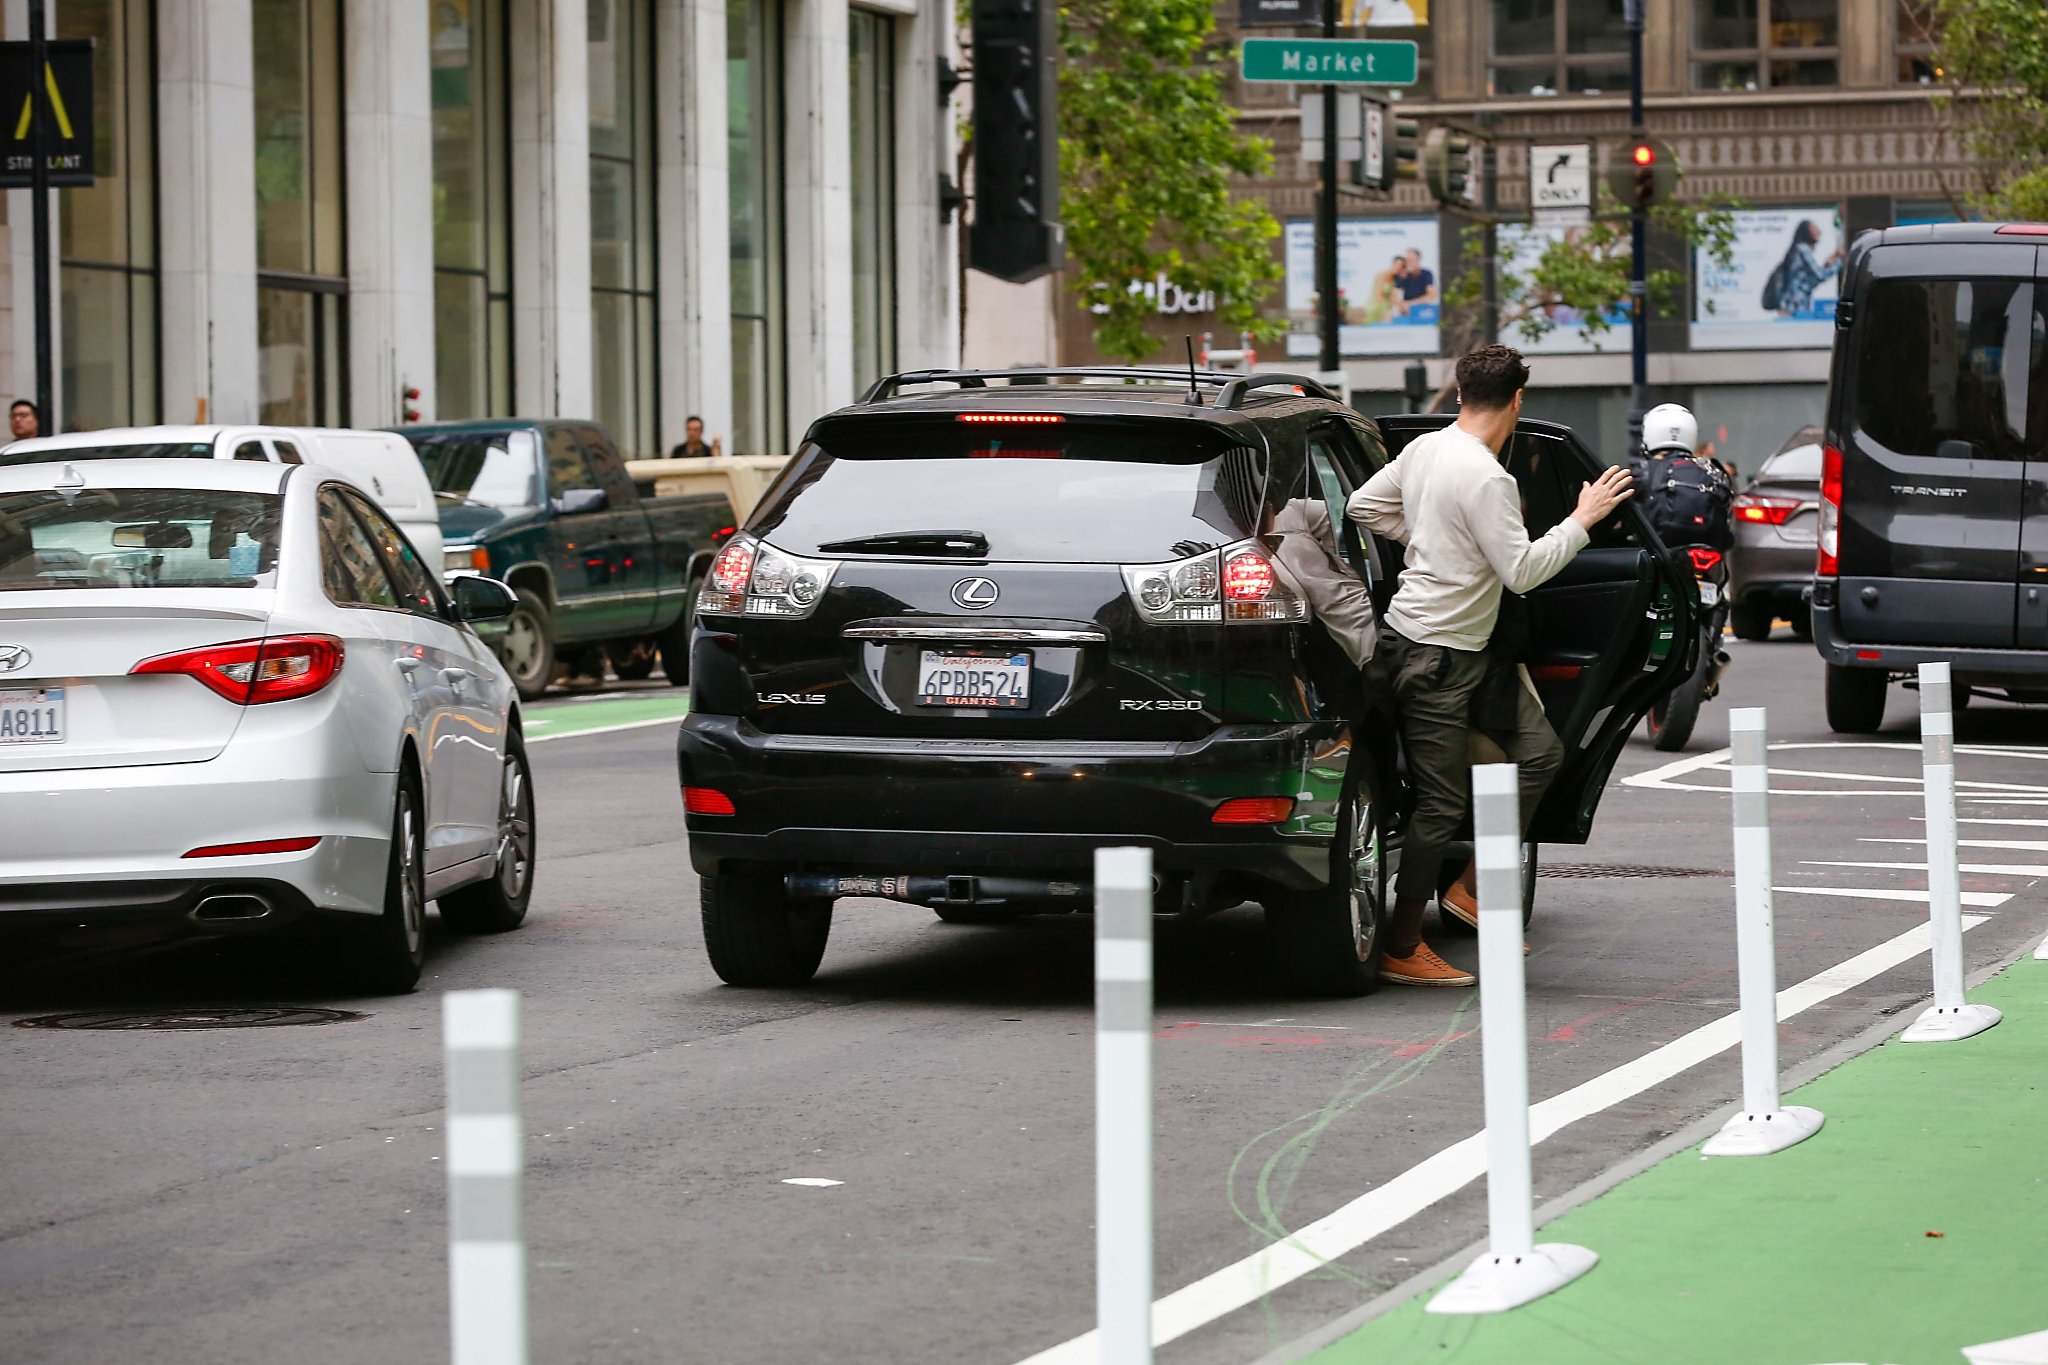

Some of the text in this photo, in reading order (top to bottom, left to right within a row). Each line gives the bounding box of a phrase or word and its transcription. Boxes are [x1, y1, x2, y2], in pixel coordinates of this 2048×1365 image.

[1283, 50, 1376, 72] Market
[8, 154, 81, 170] STIMLANT
[1539, 187, 1580, 200] ONLY
[1890, 485, 1967, 497] TRANSIT
[925, 670, 1022, 697] 6PBB524
[757, 692, 826, 705] LEXUS
[945, 696, 998, 705] GIANTS
[1120, 700, 1203, 711] RX 350
